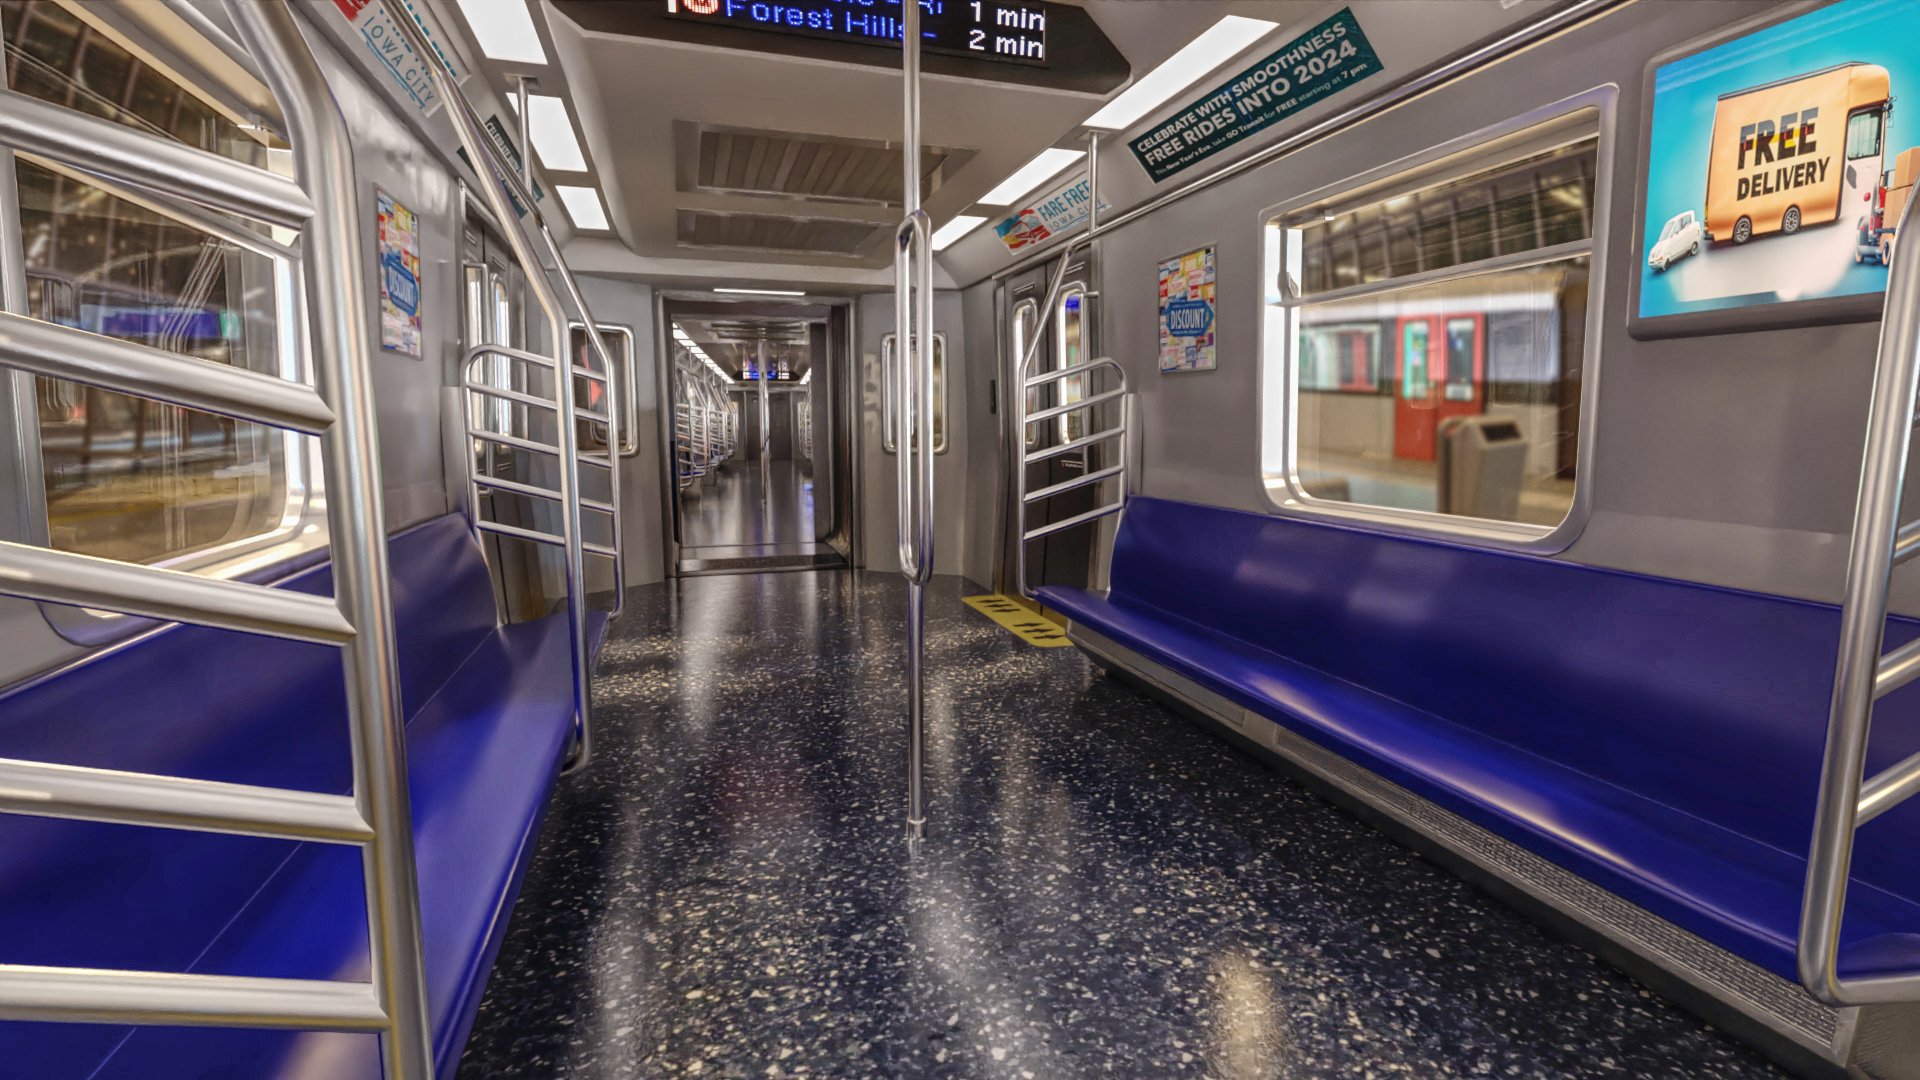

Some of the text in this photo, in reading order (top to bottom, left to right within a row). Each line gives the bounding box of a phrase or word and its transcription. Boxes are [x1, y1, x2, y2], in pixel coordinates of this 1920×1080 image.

[726, 0, 834, 30] Forest
[970, 29, 985, 50] 2
[996, 36, 1043, 58] min
[970, 2, 981, 21] 1
[997, 8, 1045, 31] min
[363, 16, 404, 67] IOWA
[405, 69, 434, 101] CITY
[1137, 22, 1347, 152] CELEBRATE WITH SMOOTHNESS
[1145, 39, 1357, 166] FREE RIDES INTO 2024
[1275, 97, 1299, 114] FREE
[1298, 80, 1332, 102] starting
[1737, 106, 1819, 171] FREE
[1736, 156, 1831, 201] DELIVERY
[1037, 196, 1069, 221] FARE
[1170, 308, 1205, 330] DISCOUNT
